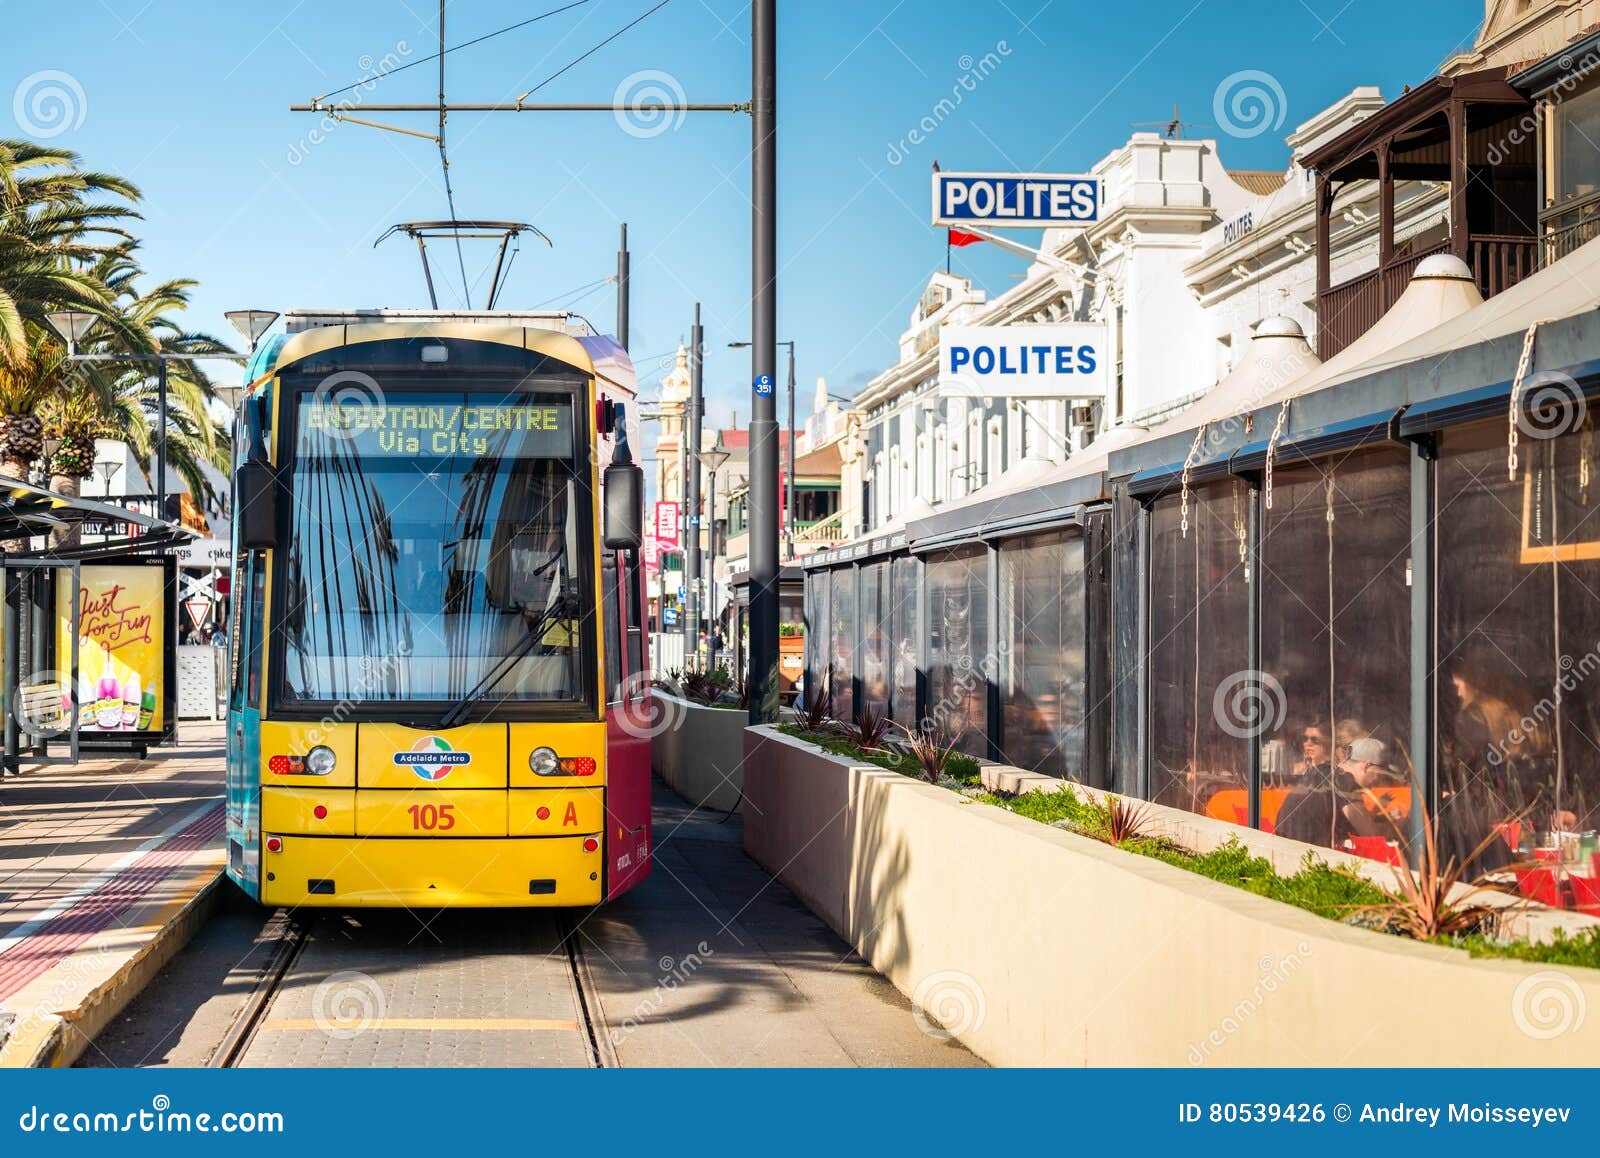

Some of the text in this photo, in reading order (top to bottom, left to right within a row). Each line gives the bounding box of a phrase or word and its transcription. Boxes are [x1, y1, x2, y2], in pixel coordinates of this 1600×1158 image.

[946, 181, 1095, 219] POLITES
[1224, 212, 1252, 245] POLITES
[950, 345, 1097, 375] POLITES
[757, 384, 772, 393] 351
[761, 376, 768, 384] G
[308, 406, 558, 431] ENTERTAIN/CENTRE
[379, 431, 487, 455] Via City
[408, 804, 455, 830] 105
[562, 801, 578, 826] A
